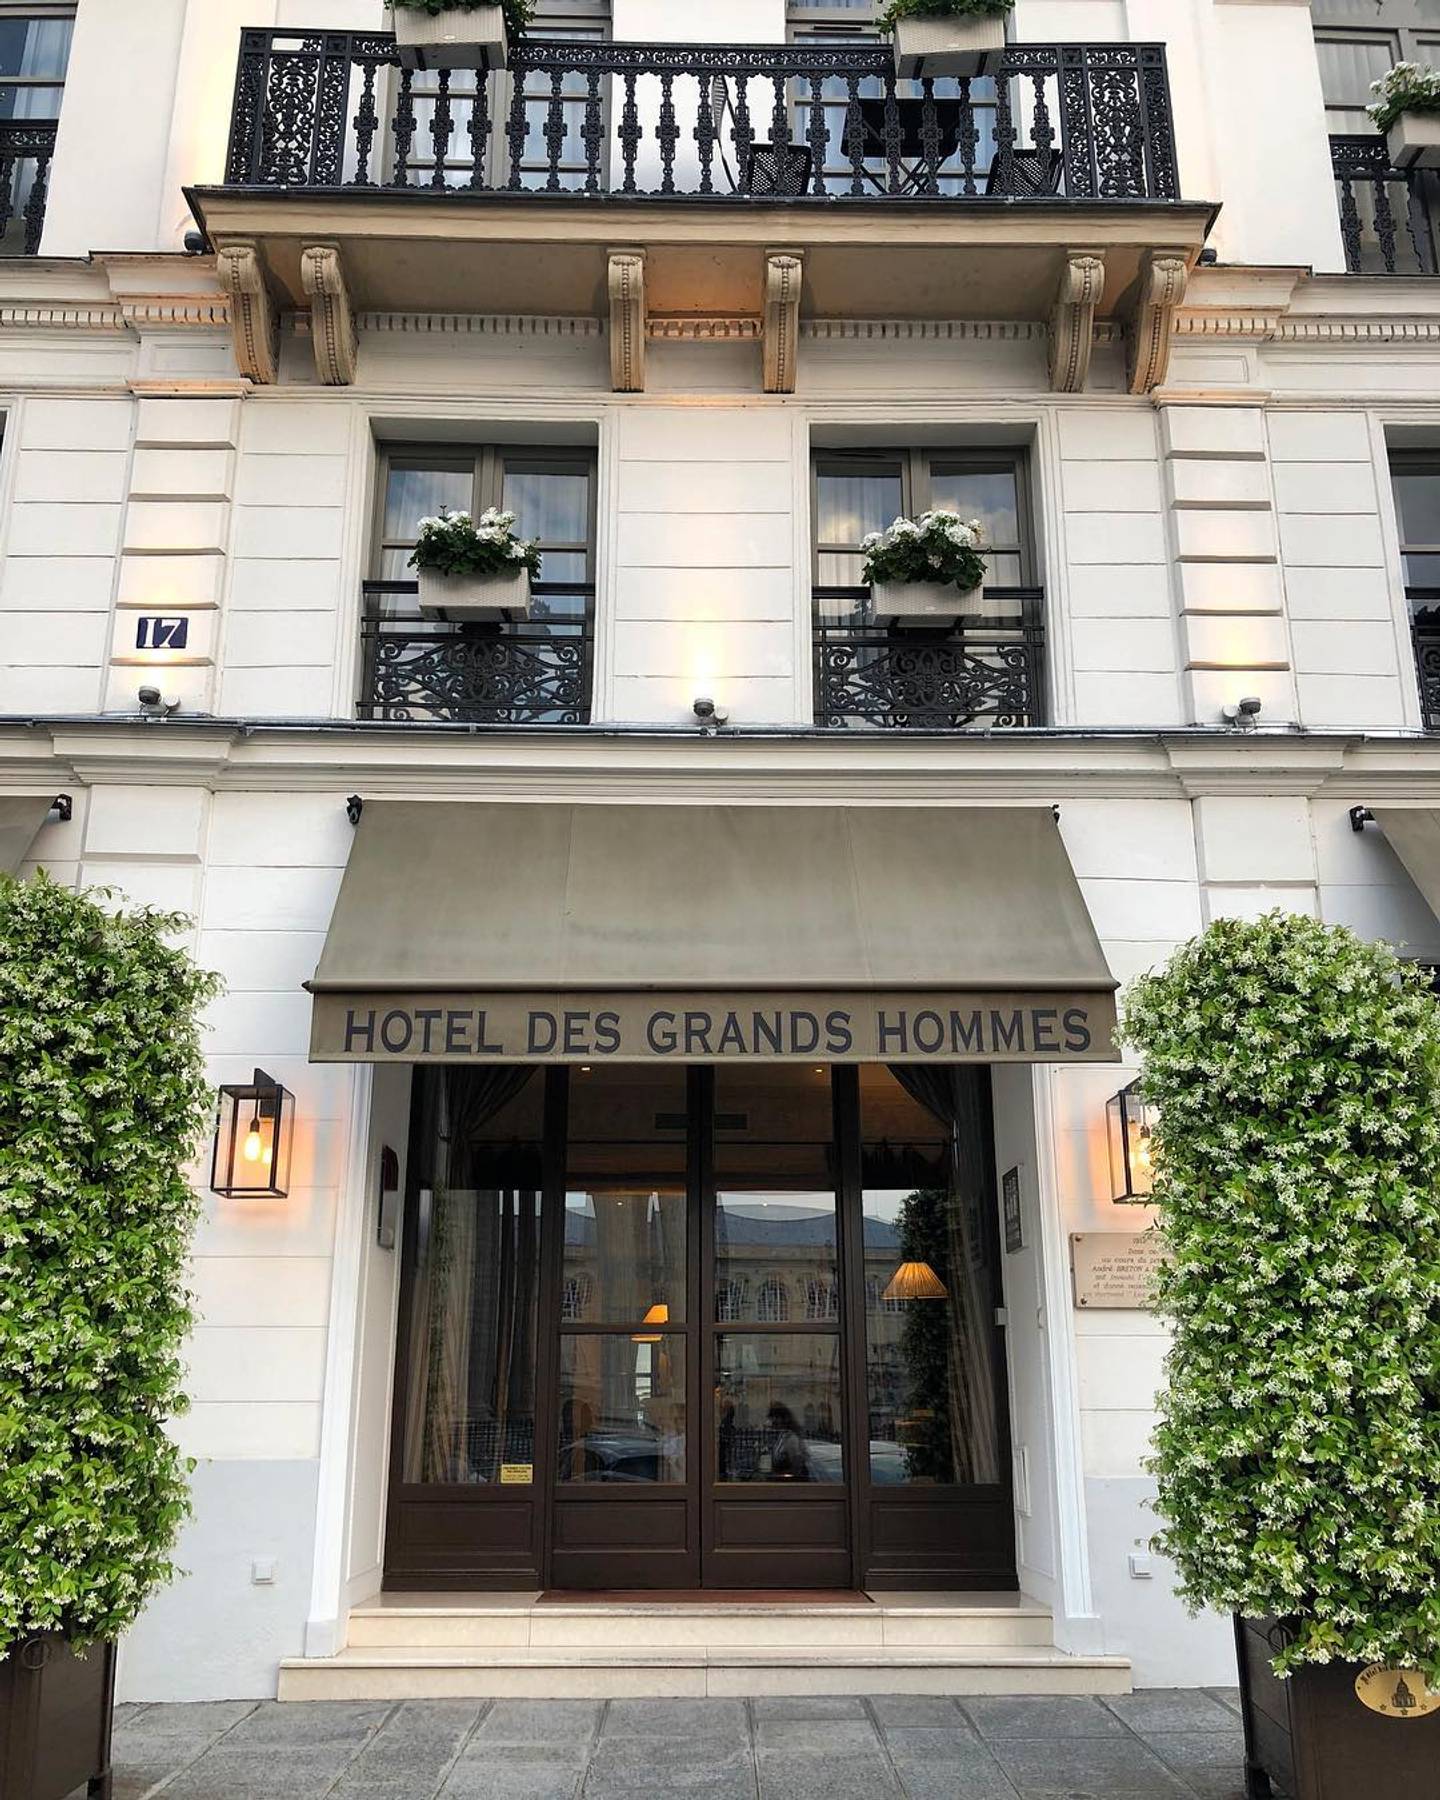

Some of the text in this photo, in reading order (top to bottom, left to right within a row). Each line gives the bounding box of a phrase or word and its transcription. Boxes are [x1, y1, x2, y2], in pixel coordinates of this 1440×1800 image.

[143, 618, 181, 648] 17
[344, 1008, 1091, 1055] HOTEL DES GRANDS HOMMES
